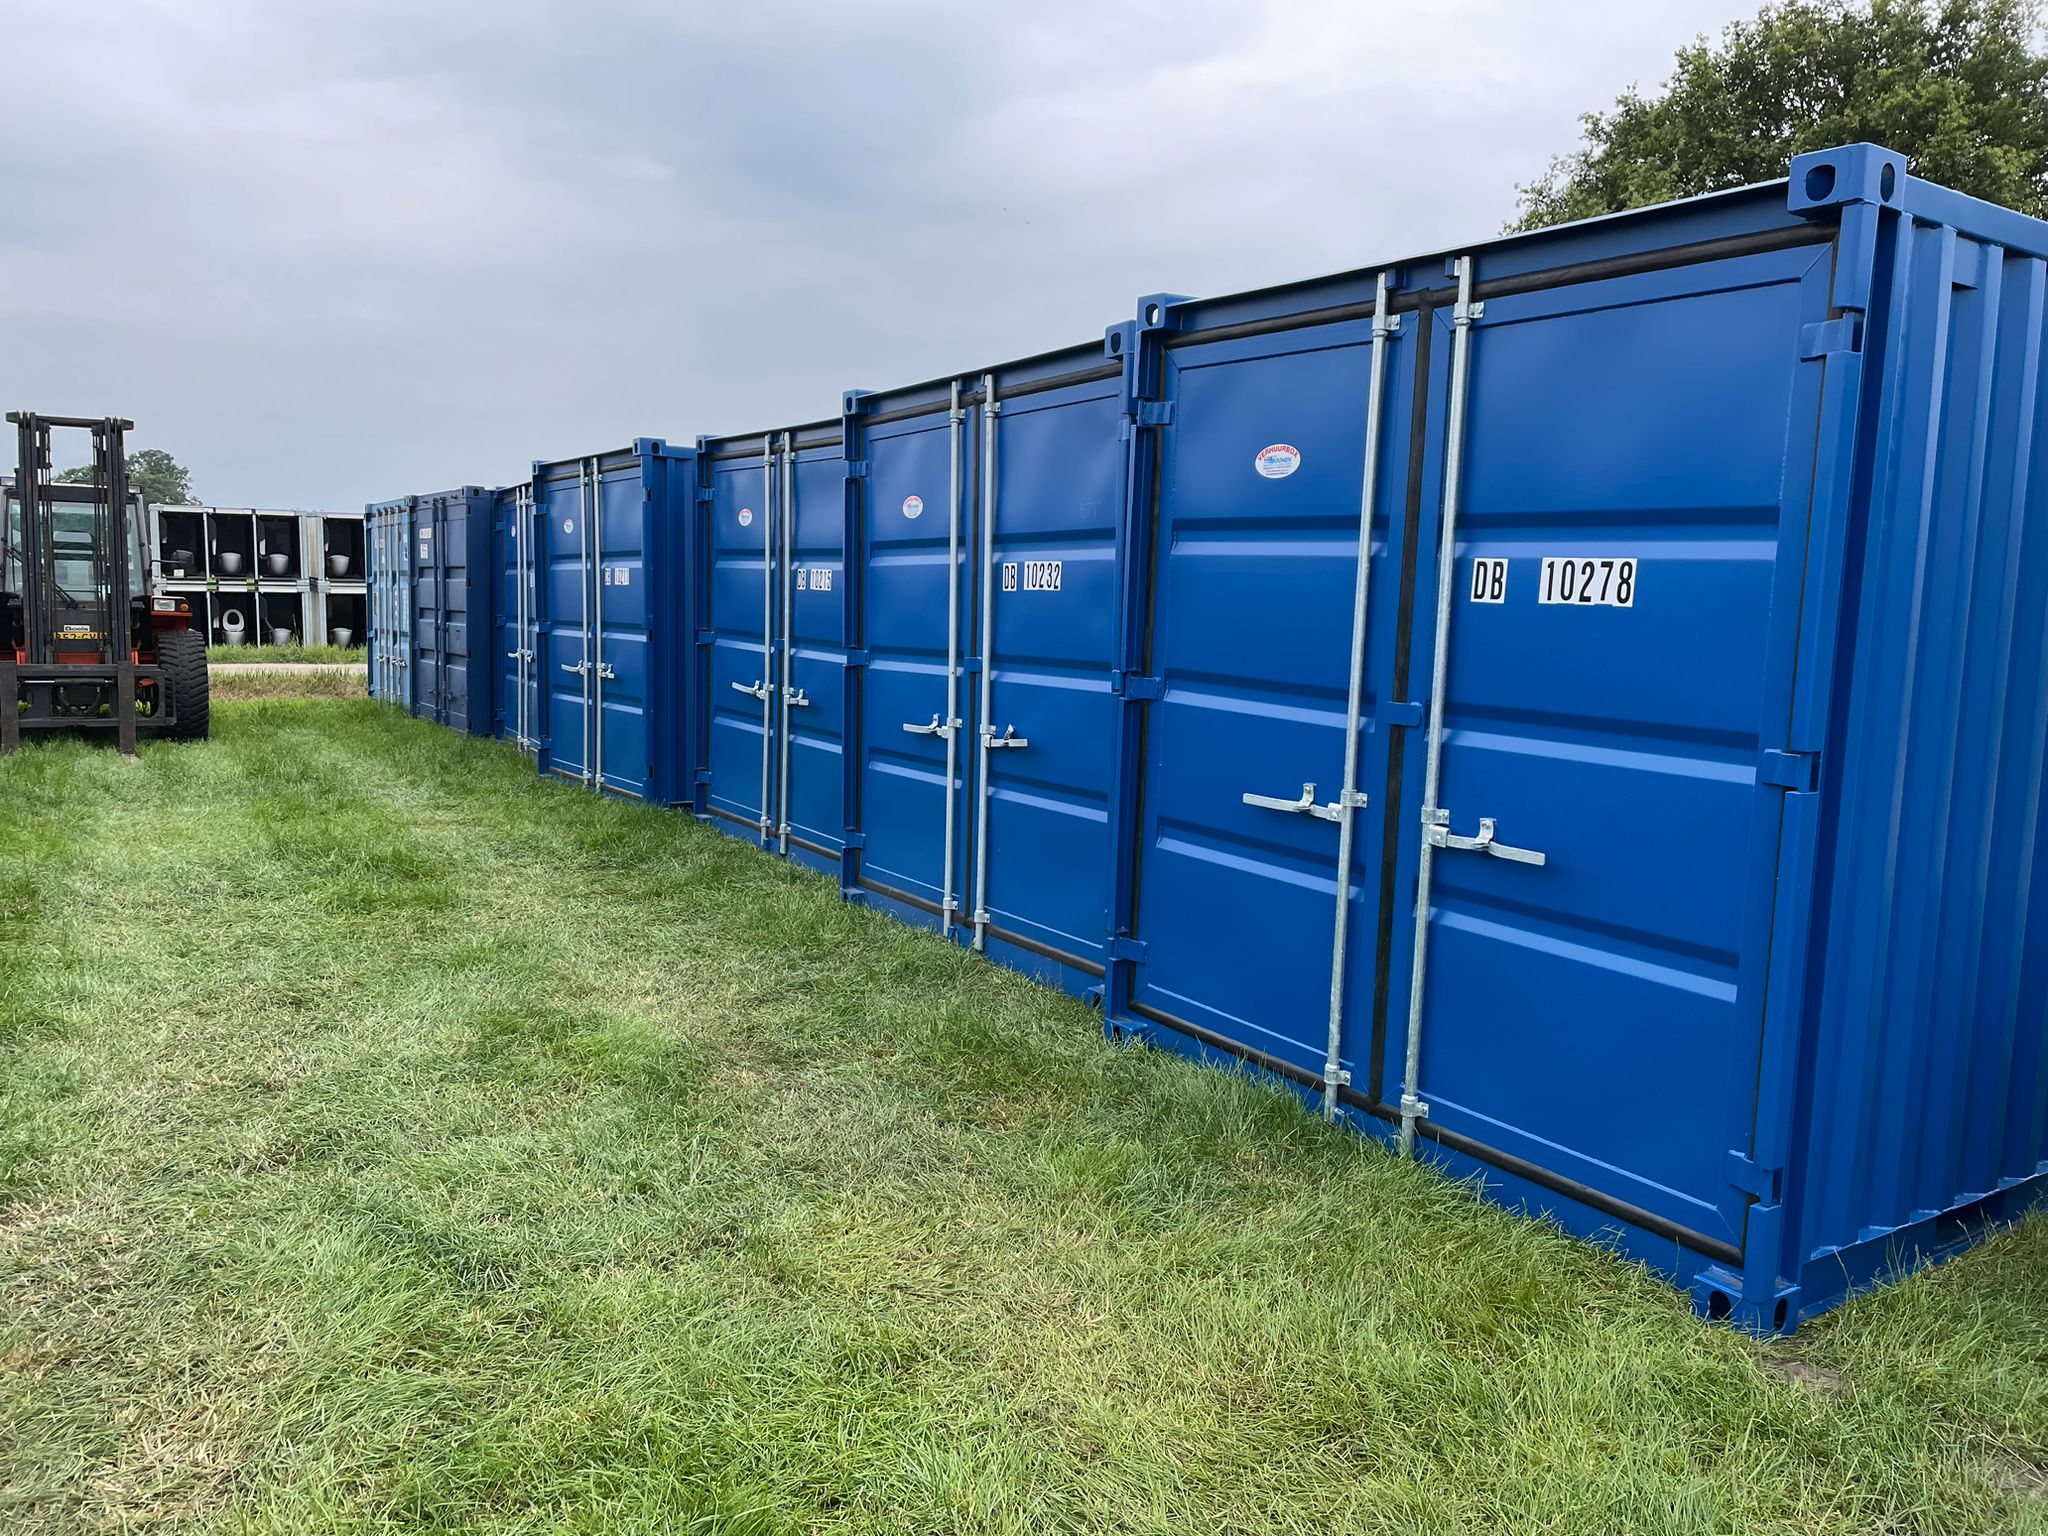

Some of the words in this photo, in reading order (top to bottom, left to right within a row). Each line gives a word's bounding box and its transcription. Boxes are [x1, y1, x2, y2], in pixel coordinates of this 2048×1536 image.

[1258, 445, 1299, 461] VERHUURBOX
[798, 569, 806, 589] DB
[1004, 564, 1016, 590] DB
[1026, 562, 1060, 590] 10232
[1473, 560, 1504, 600] DB
[1547, 560, 1633, 604] 10278
